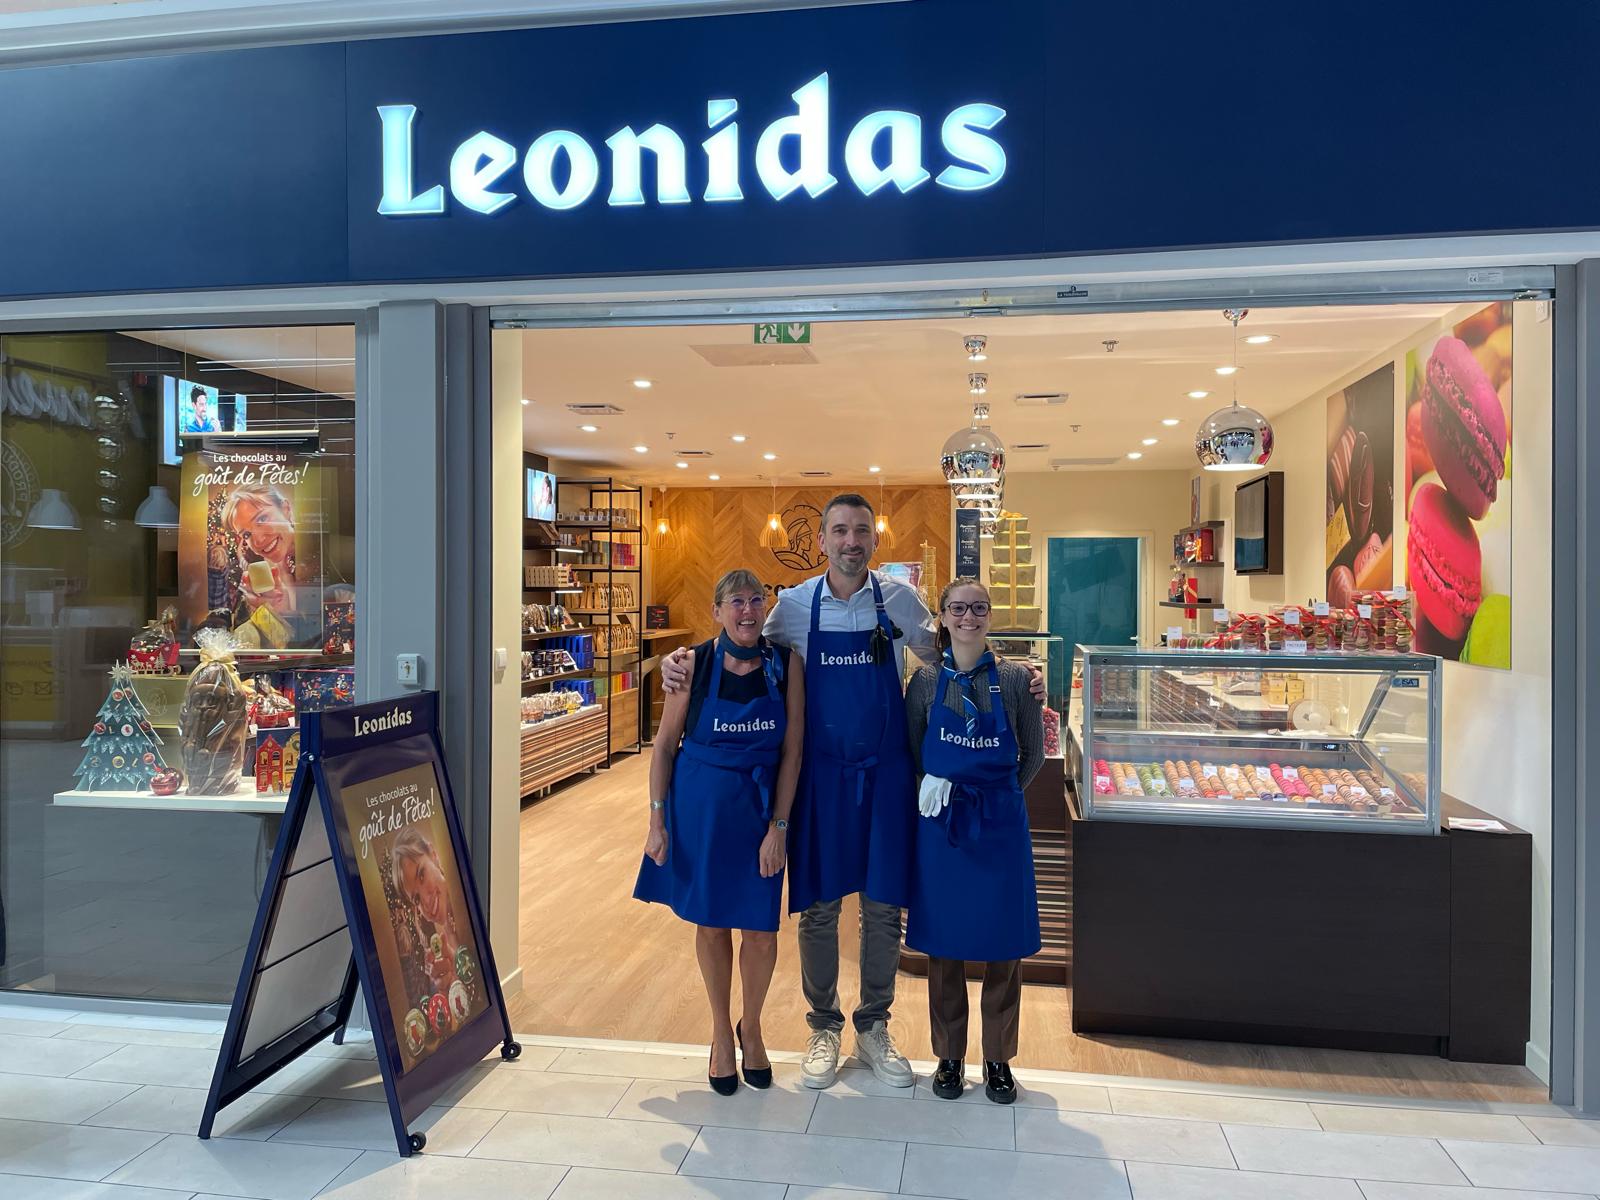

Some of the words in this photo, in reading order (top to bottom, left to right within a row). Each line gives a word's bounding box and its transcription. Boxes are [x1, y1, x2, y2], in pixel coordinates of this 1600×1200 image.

[377, 72, 1007, 214] Leonidas
[213, 454, 228, 463] Les
[230, 453, 274, 462] chocolats
[275, 454, 287, 462] au
[192, 465, 233, 497] goût
[233, 465, 256, 485] de
[258, 461, 309, 486] Fêtes!
[820, 651, 874, 666] Leonida
[353, 706, 413, 737] Leonidas
[713, 717, 776, 733] Leonidas
[940, 727, 1000, 749] Leonidas
[366, 797, 379, 808] Les
[379, 786, 410, 805] chocolats
[409, 782, 418, 794] au
[359, 810, 386, 860] goût
[387, 805, 403, 831] de
[402, 787, 435, 826] Fêtes!
